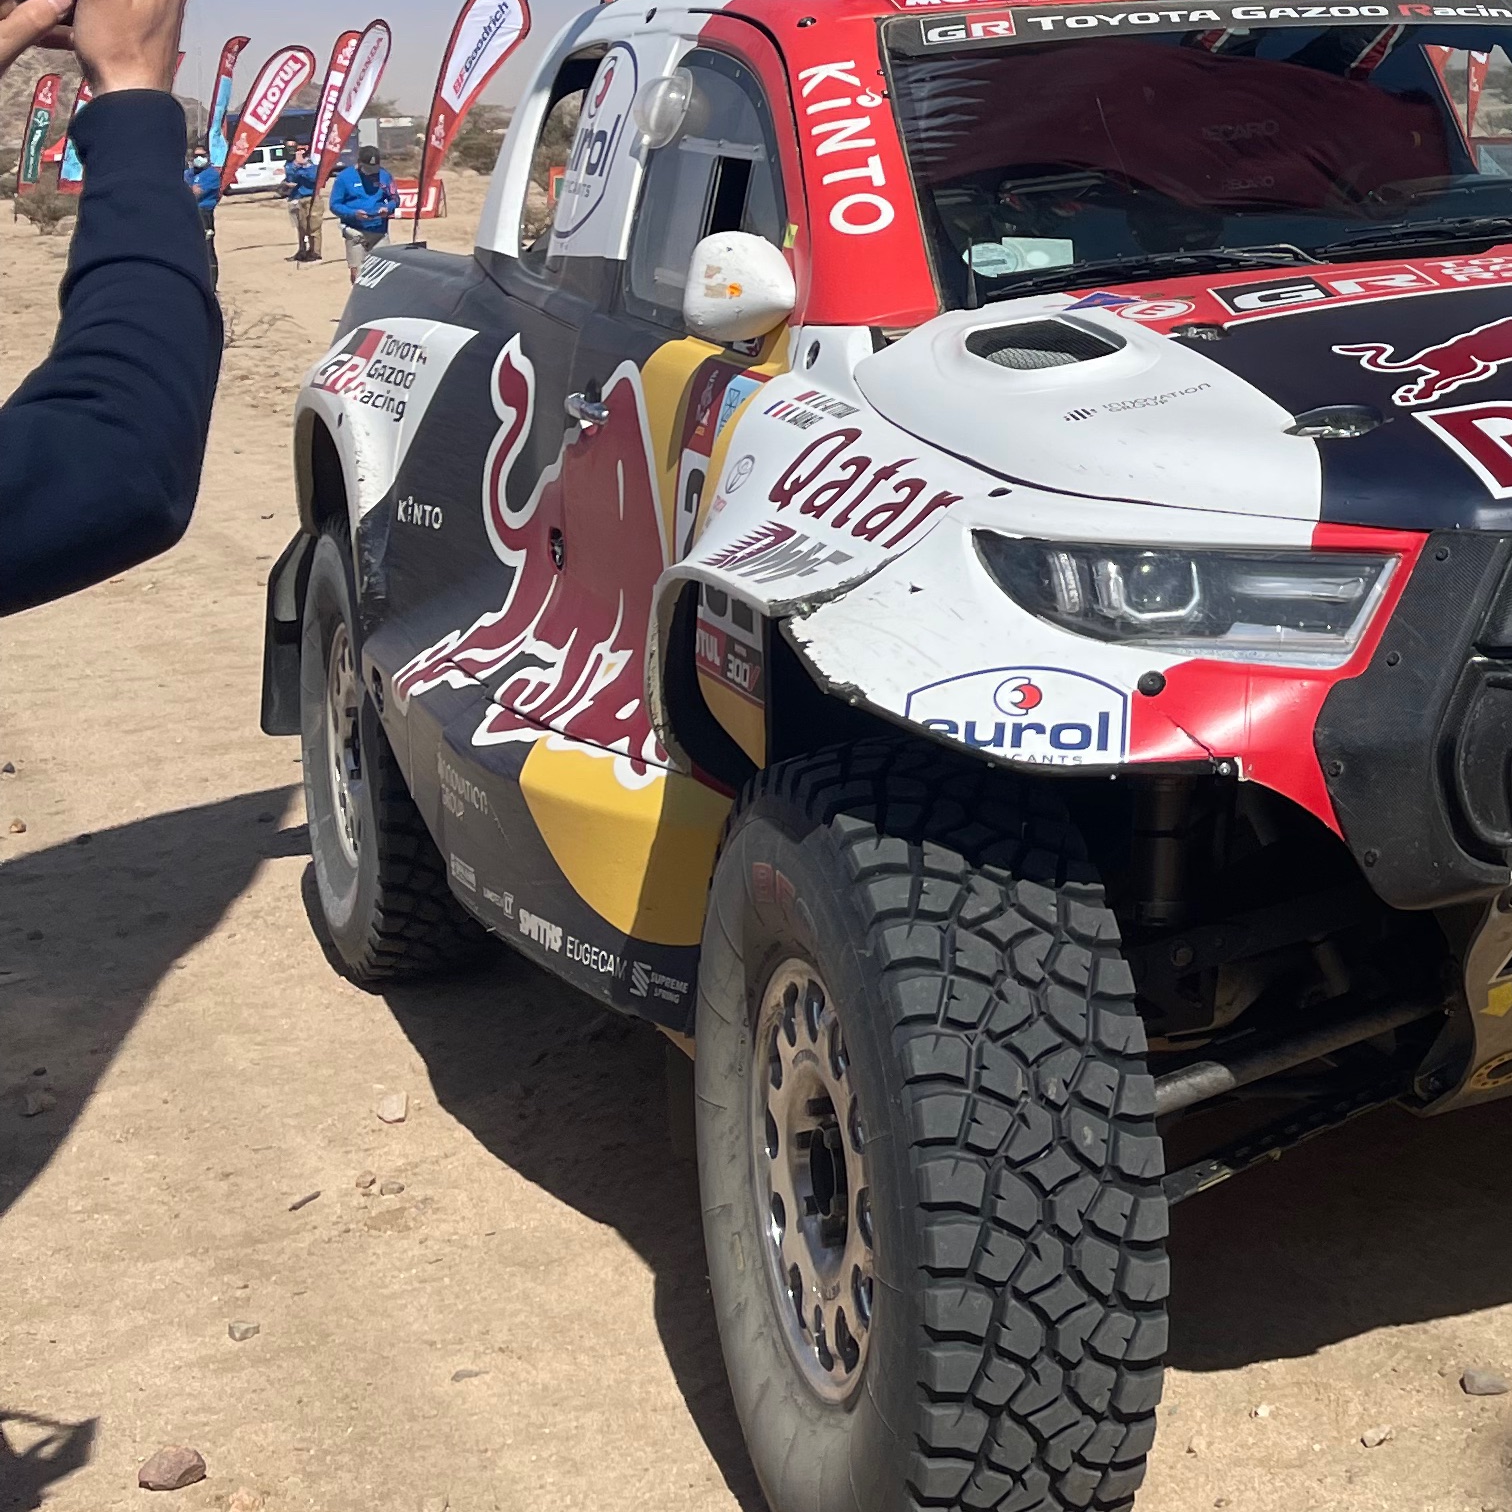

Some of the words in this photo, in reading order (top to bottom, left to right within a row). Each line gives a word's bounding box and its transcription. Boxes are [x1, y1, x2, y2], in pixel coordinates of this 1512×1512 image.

[927, 21, 1012, 43] GR
[1028, 9, 1221, 31] TOYOTA
[1231, 5, 1388, 20] GAZOO
[453, 1, 509, 96] BFGoodrich
[256, 59, 301, 121] MOTUL
[1233, 274, 1427, 310] GR
[380, 334, 428, 366] TOYOTA
[366, 359, 416, 390] GAZOO
[768, 428, 964, 549] Qatar
[921, 711, 1110, 752] eurol
[566, 935, 627, 981] EDGECAM
